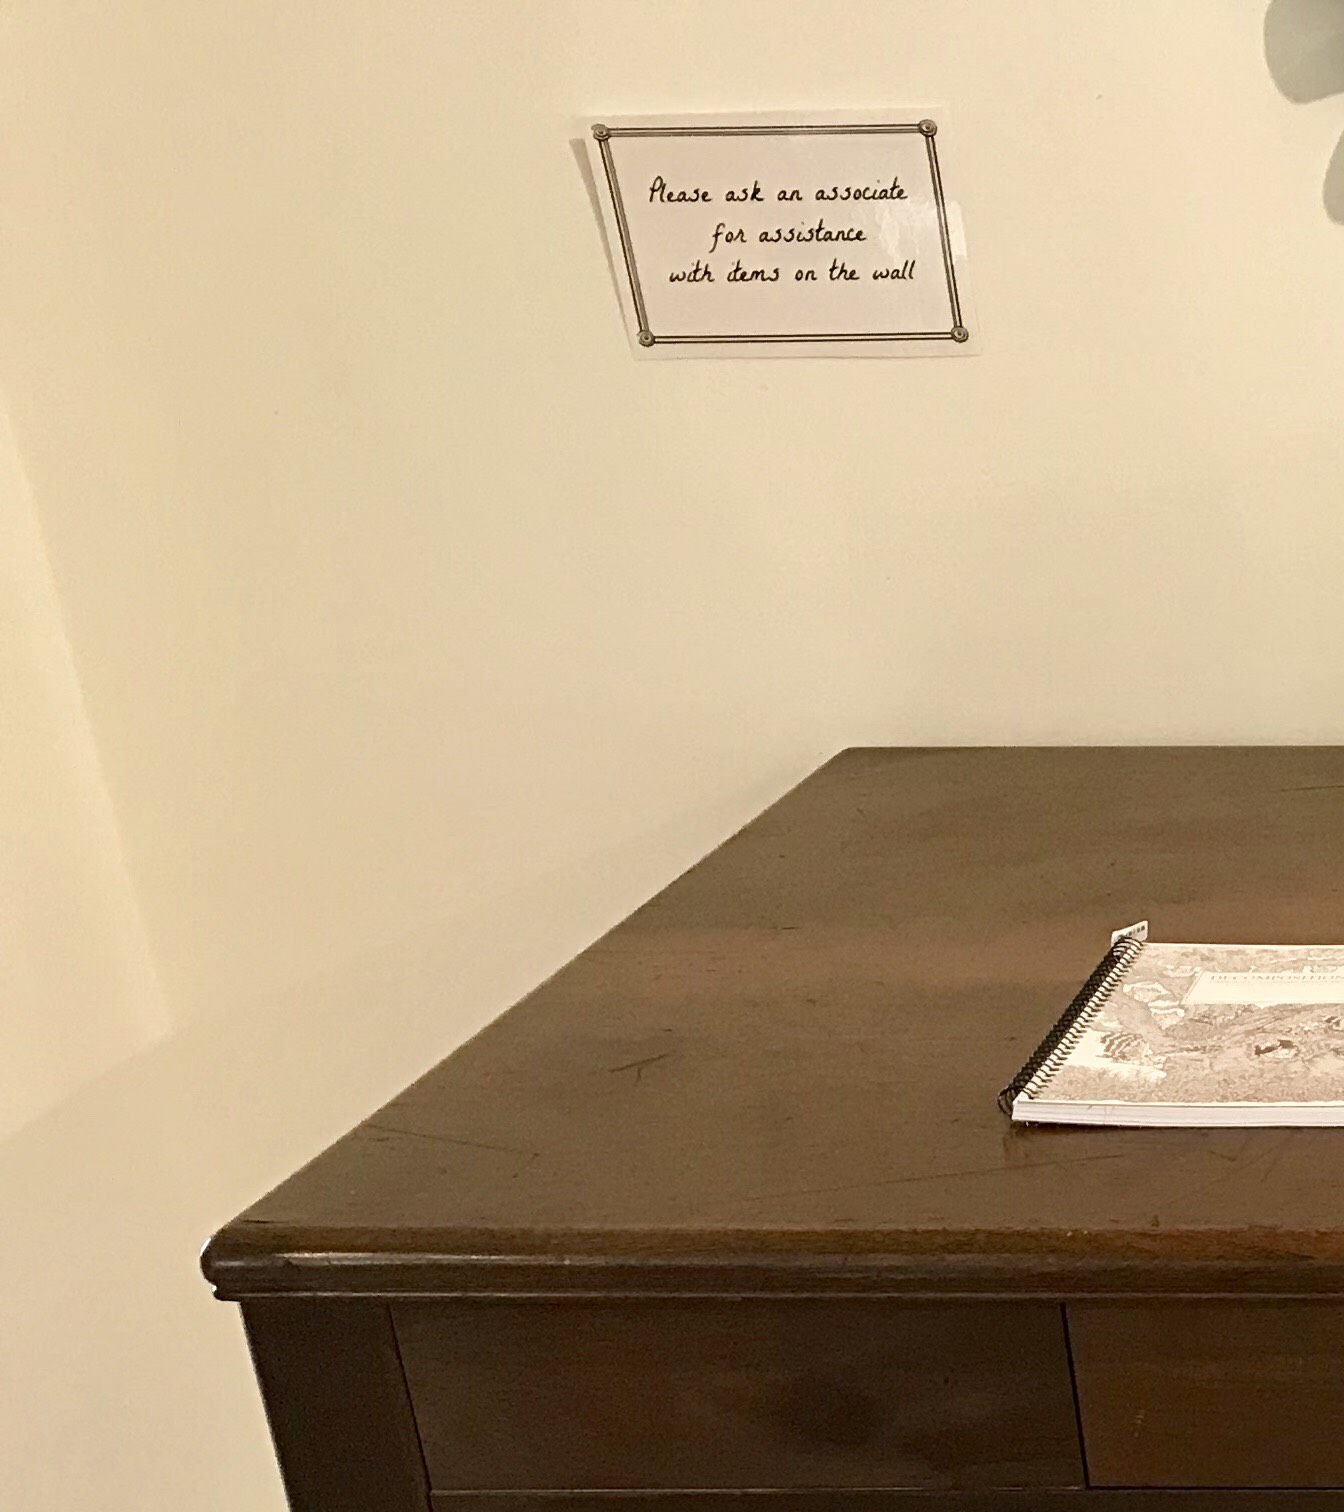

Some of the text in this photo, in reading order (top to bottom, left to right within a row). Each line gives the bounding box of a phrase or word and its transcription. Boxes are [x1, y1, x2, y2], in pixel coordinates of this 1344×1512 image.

[649, 175, 908, 203] Please ask an associate
[708, 218, 867, 253] for assistance
[669, 257, 916, 283] with items on the wall
